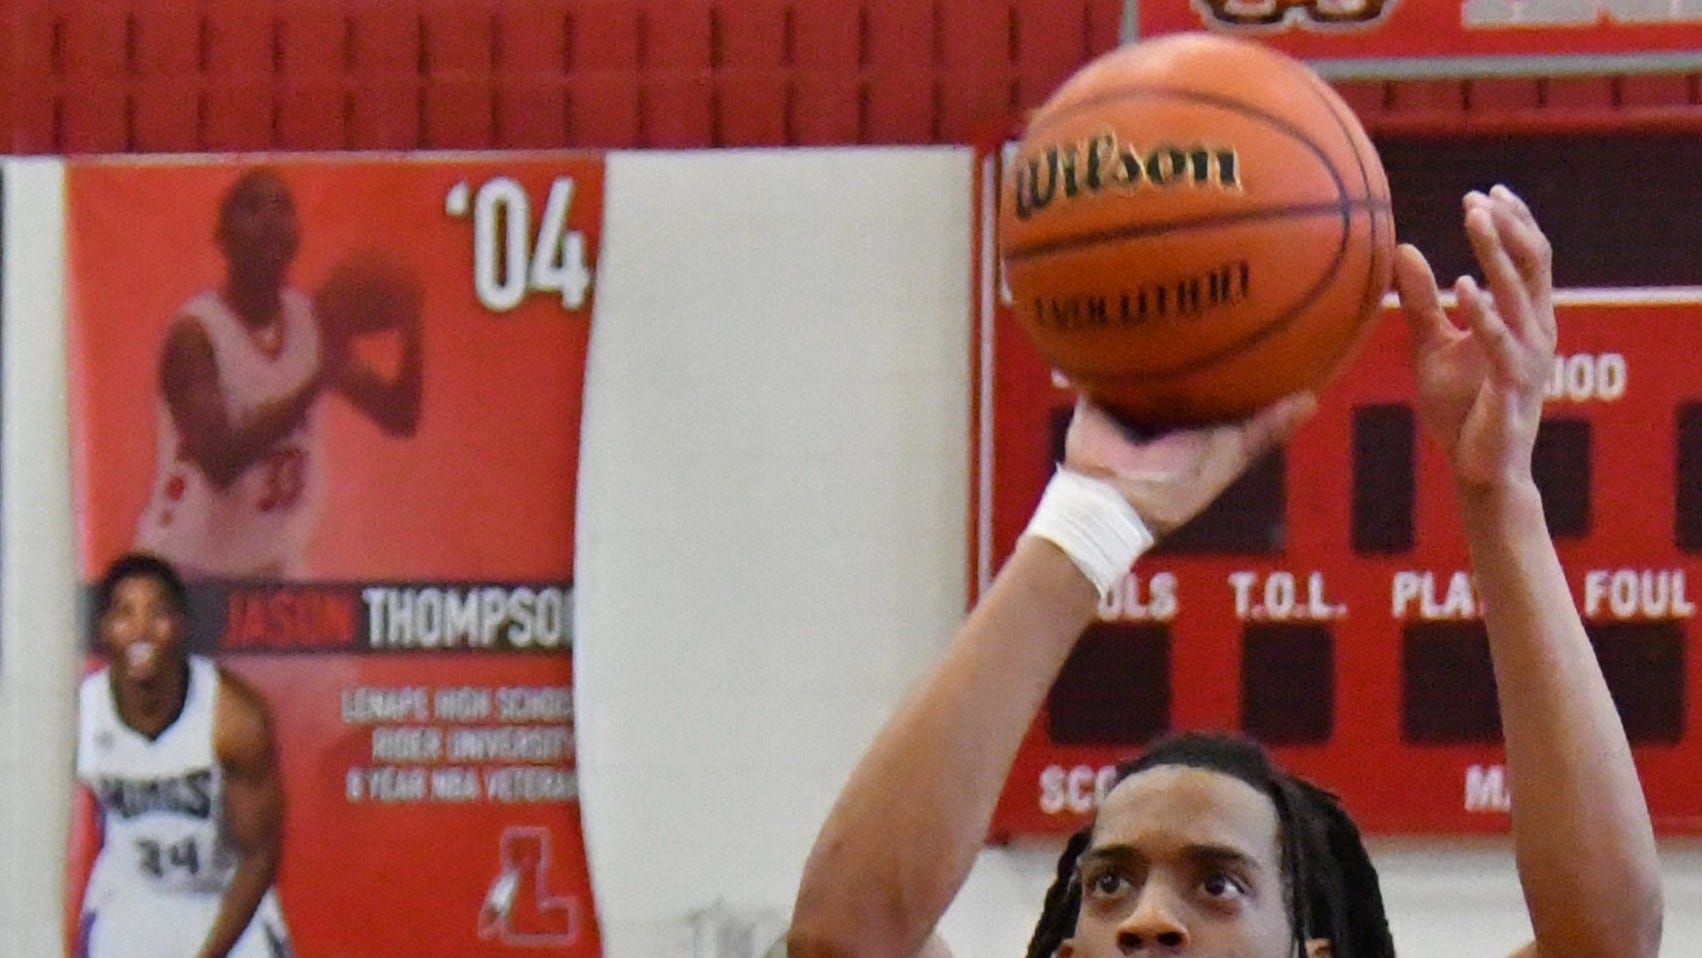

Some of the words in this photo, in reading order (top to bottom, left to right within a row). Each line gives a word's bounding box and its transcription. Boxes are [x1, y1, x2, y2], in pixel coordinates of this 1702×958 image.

[1016, 127, 1244, 220] Wilson
[1545, 353, 1627, 401] IOD
[1097, 571, 1178, 621] ULS
[1228, 570, 1347, 620] T.O.L.
[1392, 570, 1476, 620] PLA
[1584, 568, 1695, 618] FOUL
[434, 686, 490, 721] HIGH
[368, 766, 427, 801] YEAR
[431, 766, 479, 801] NBA
